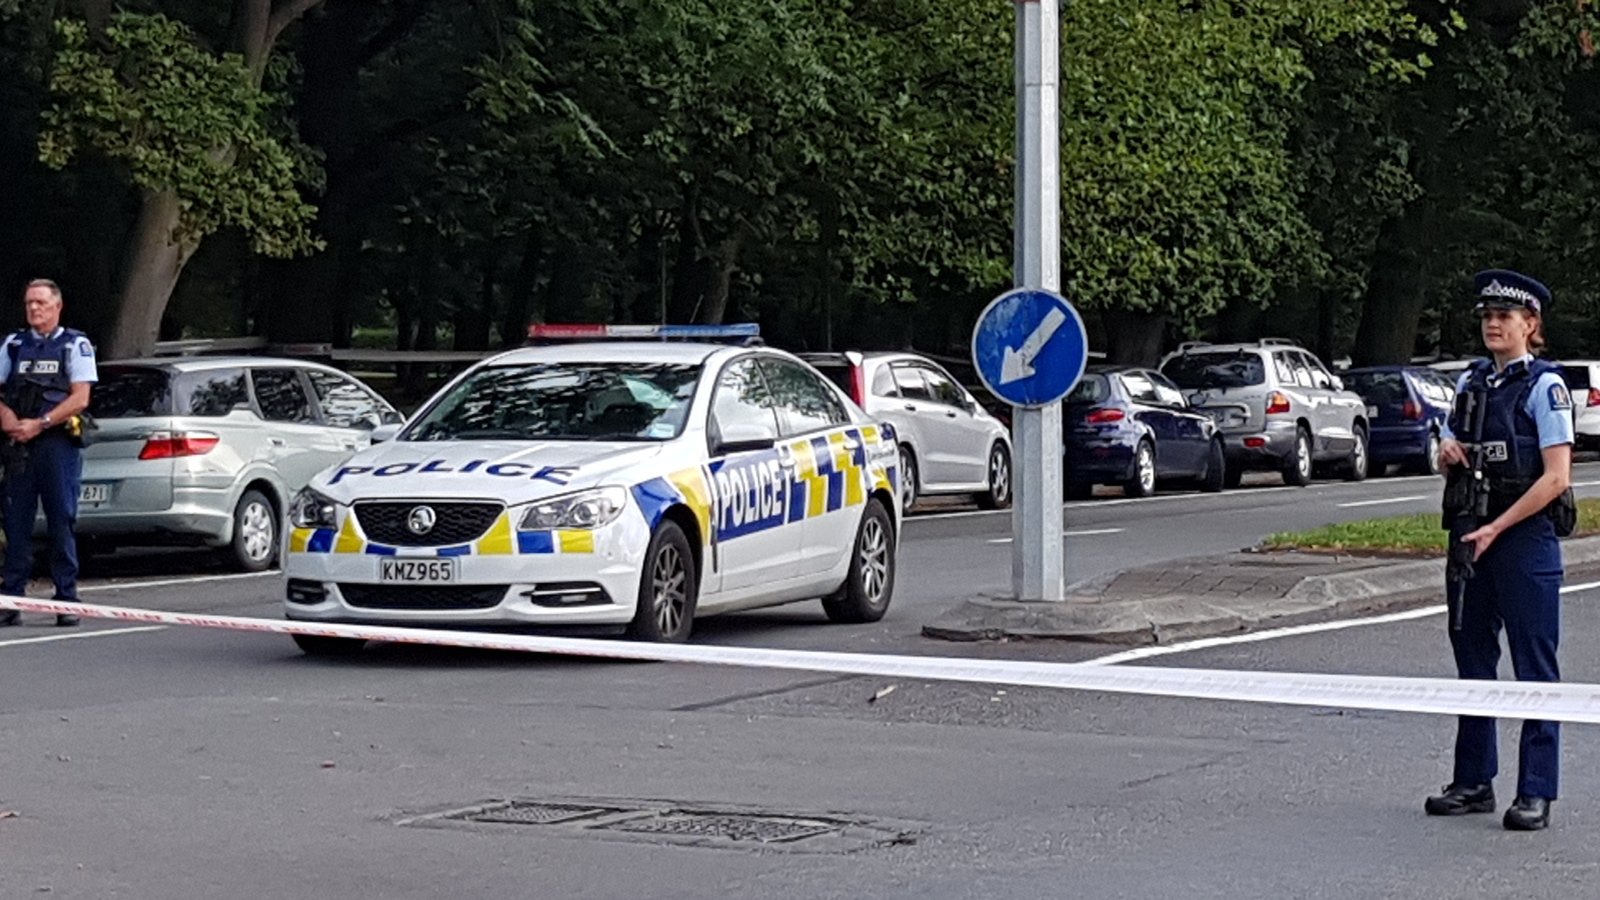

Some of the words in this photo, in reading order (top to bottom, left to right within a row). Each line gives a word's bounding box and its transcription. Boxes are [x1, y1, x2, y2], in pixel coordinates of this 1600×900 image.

[327, 459, 580, 486] POLICE
[82, 485, 104, 500] 671
[715, 459, 783, 531] POLICE
[382, 560, 451, 582] KMZ965
